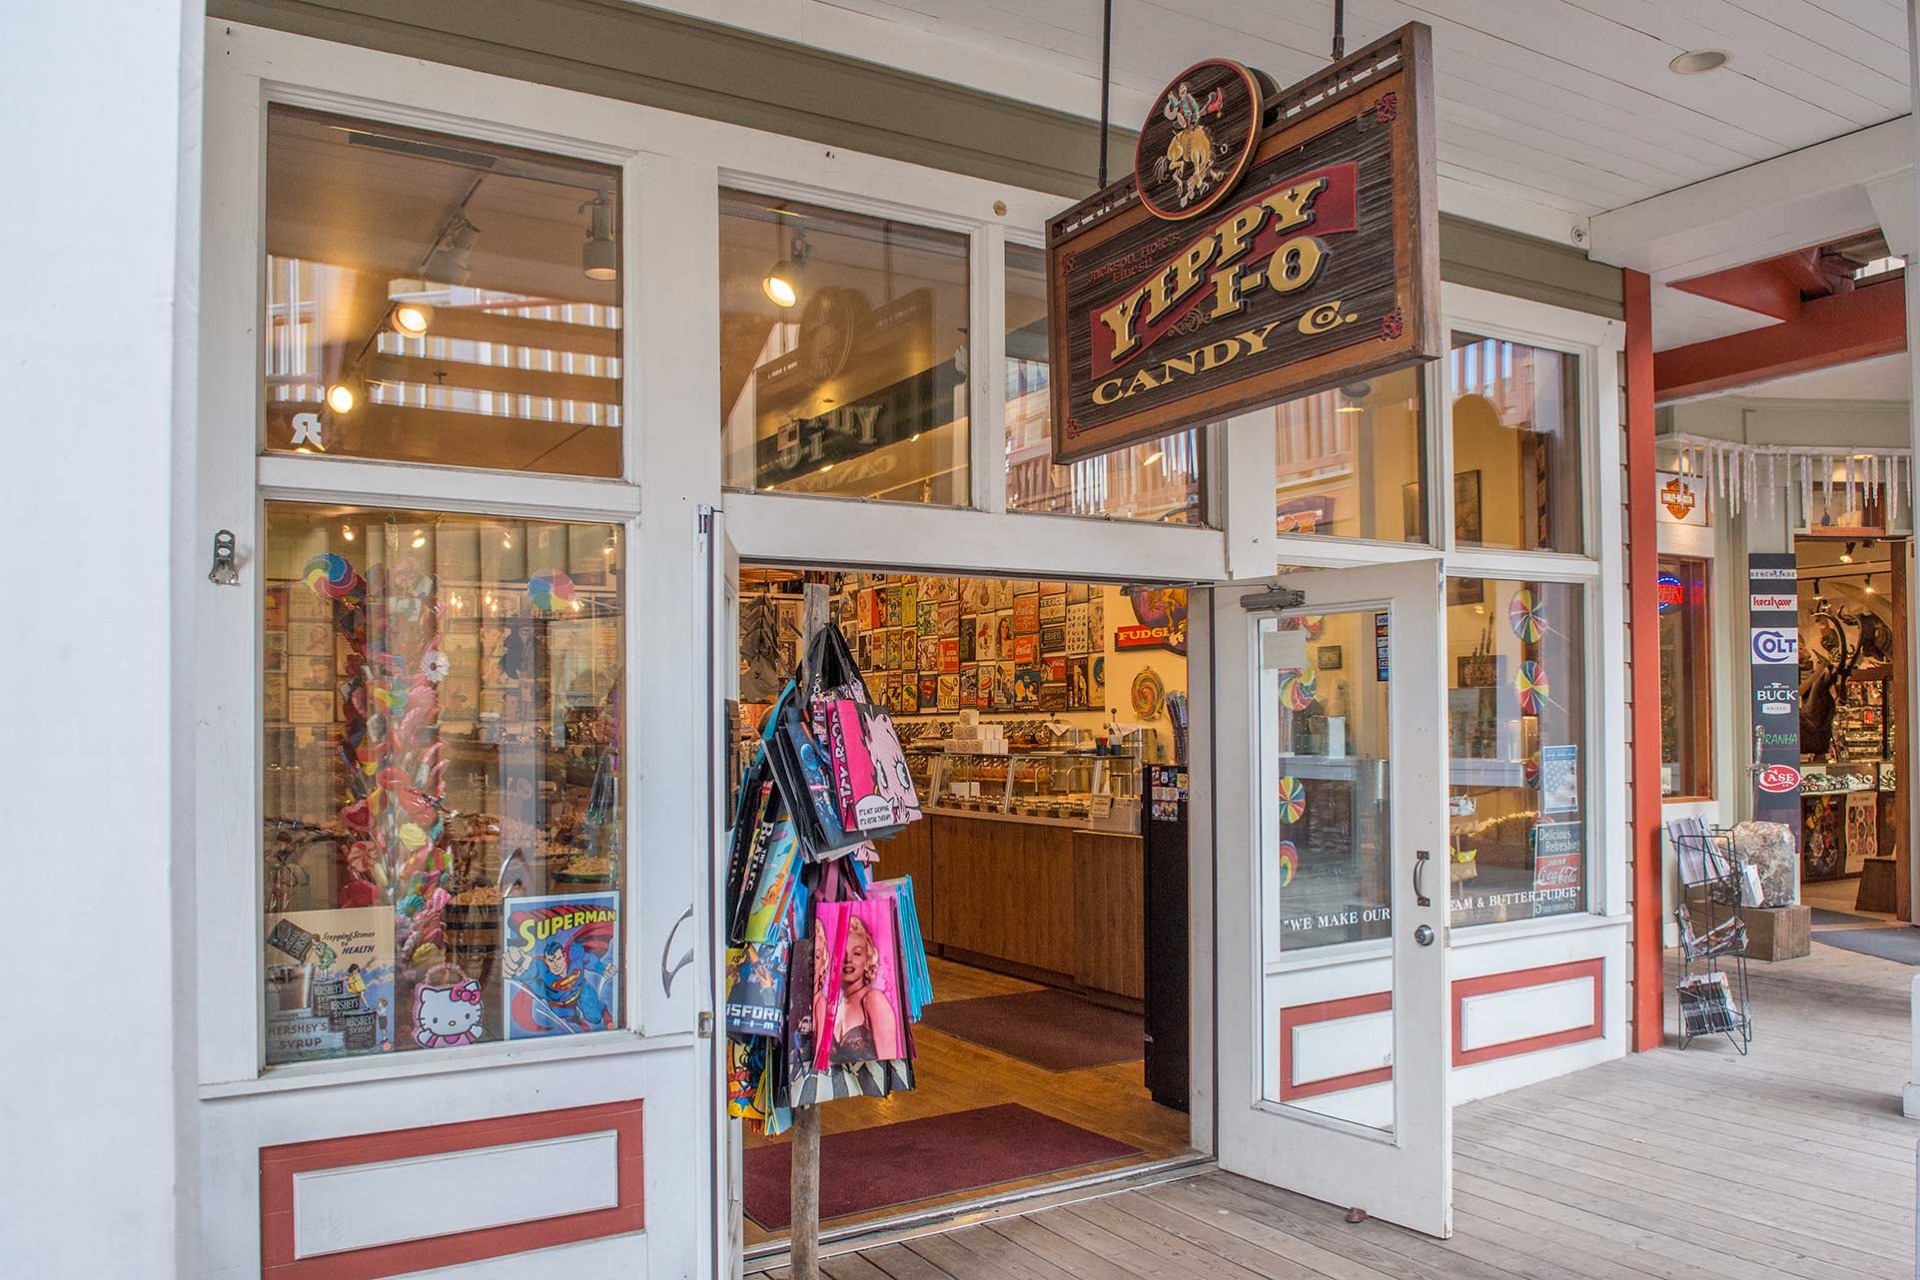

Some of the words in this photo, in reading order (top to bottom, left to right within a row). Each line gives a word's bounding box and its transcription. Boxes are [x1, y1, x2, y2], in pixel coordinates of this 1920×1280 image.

[1087, 253, 1136, 285] Jackson
[1100, 177, 1328, 361] YIPPY
[1209, 237, 1327, 321] I-O
[1092, 321, 1280, 406] CANDY
[1753, 596, 1793, 609] kershaw
[1118, 627, 1171, 641] FUDGE
[1753, 630, 1797, 663] COLT
[1757, 690, 1797, 701] BUCK
[1762, 733, 1798, 745] IRANHA
[1539, 827, 1572, 842] Delicious
[1545, 838, 1581, 853] Refreshing
[1477, 894, 1486, 909] &
[1489, 891, 1536, 907] BUTTER
[1317, 911, 1359, 928] MAKE
[1363, 907, 1390, 923] OUR
[520, 910, 616, 953] SUPERMAN
[342, 944, 375, 955] HEALTH
[269, 1021, 328, 1037] HERSHEY'S
[349, 1025, 373, 1034] SYRUP
[279, 1037, 322, 1050] SYRUP
